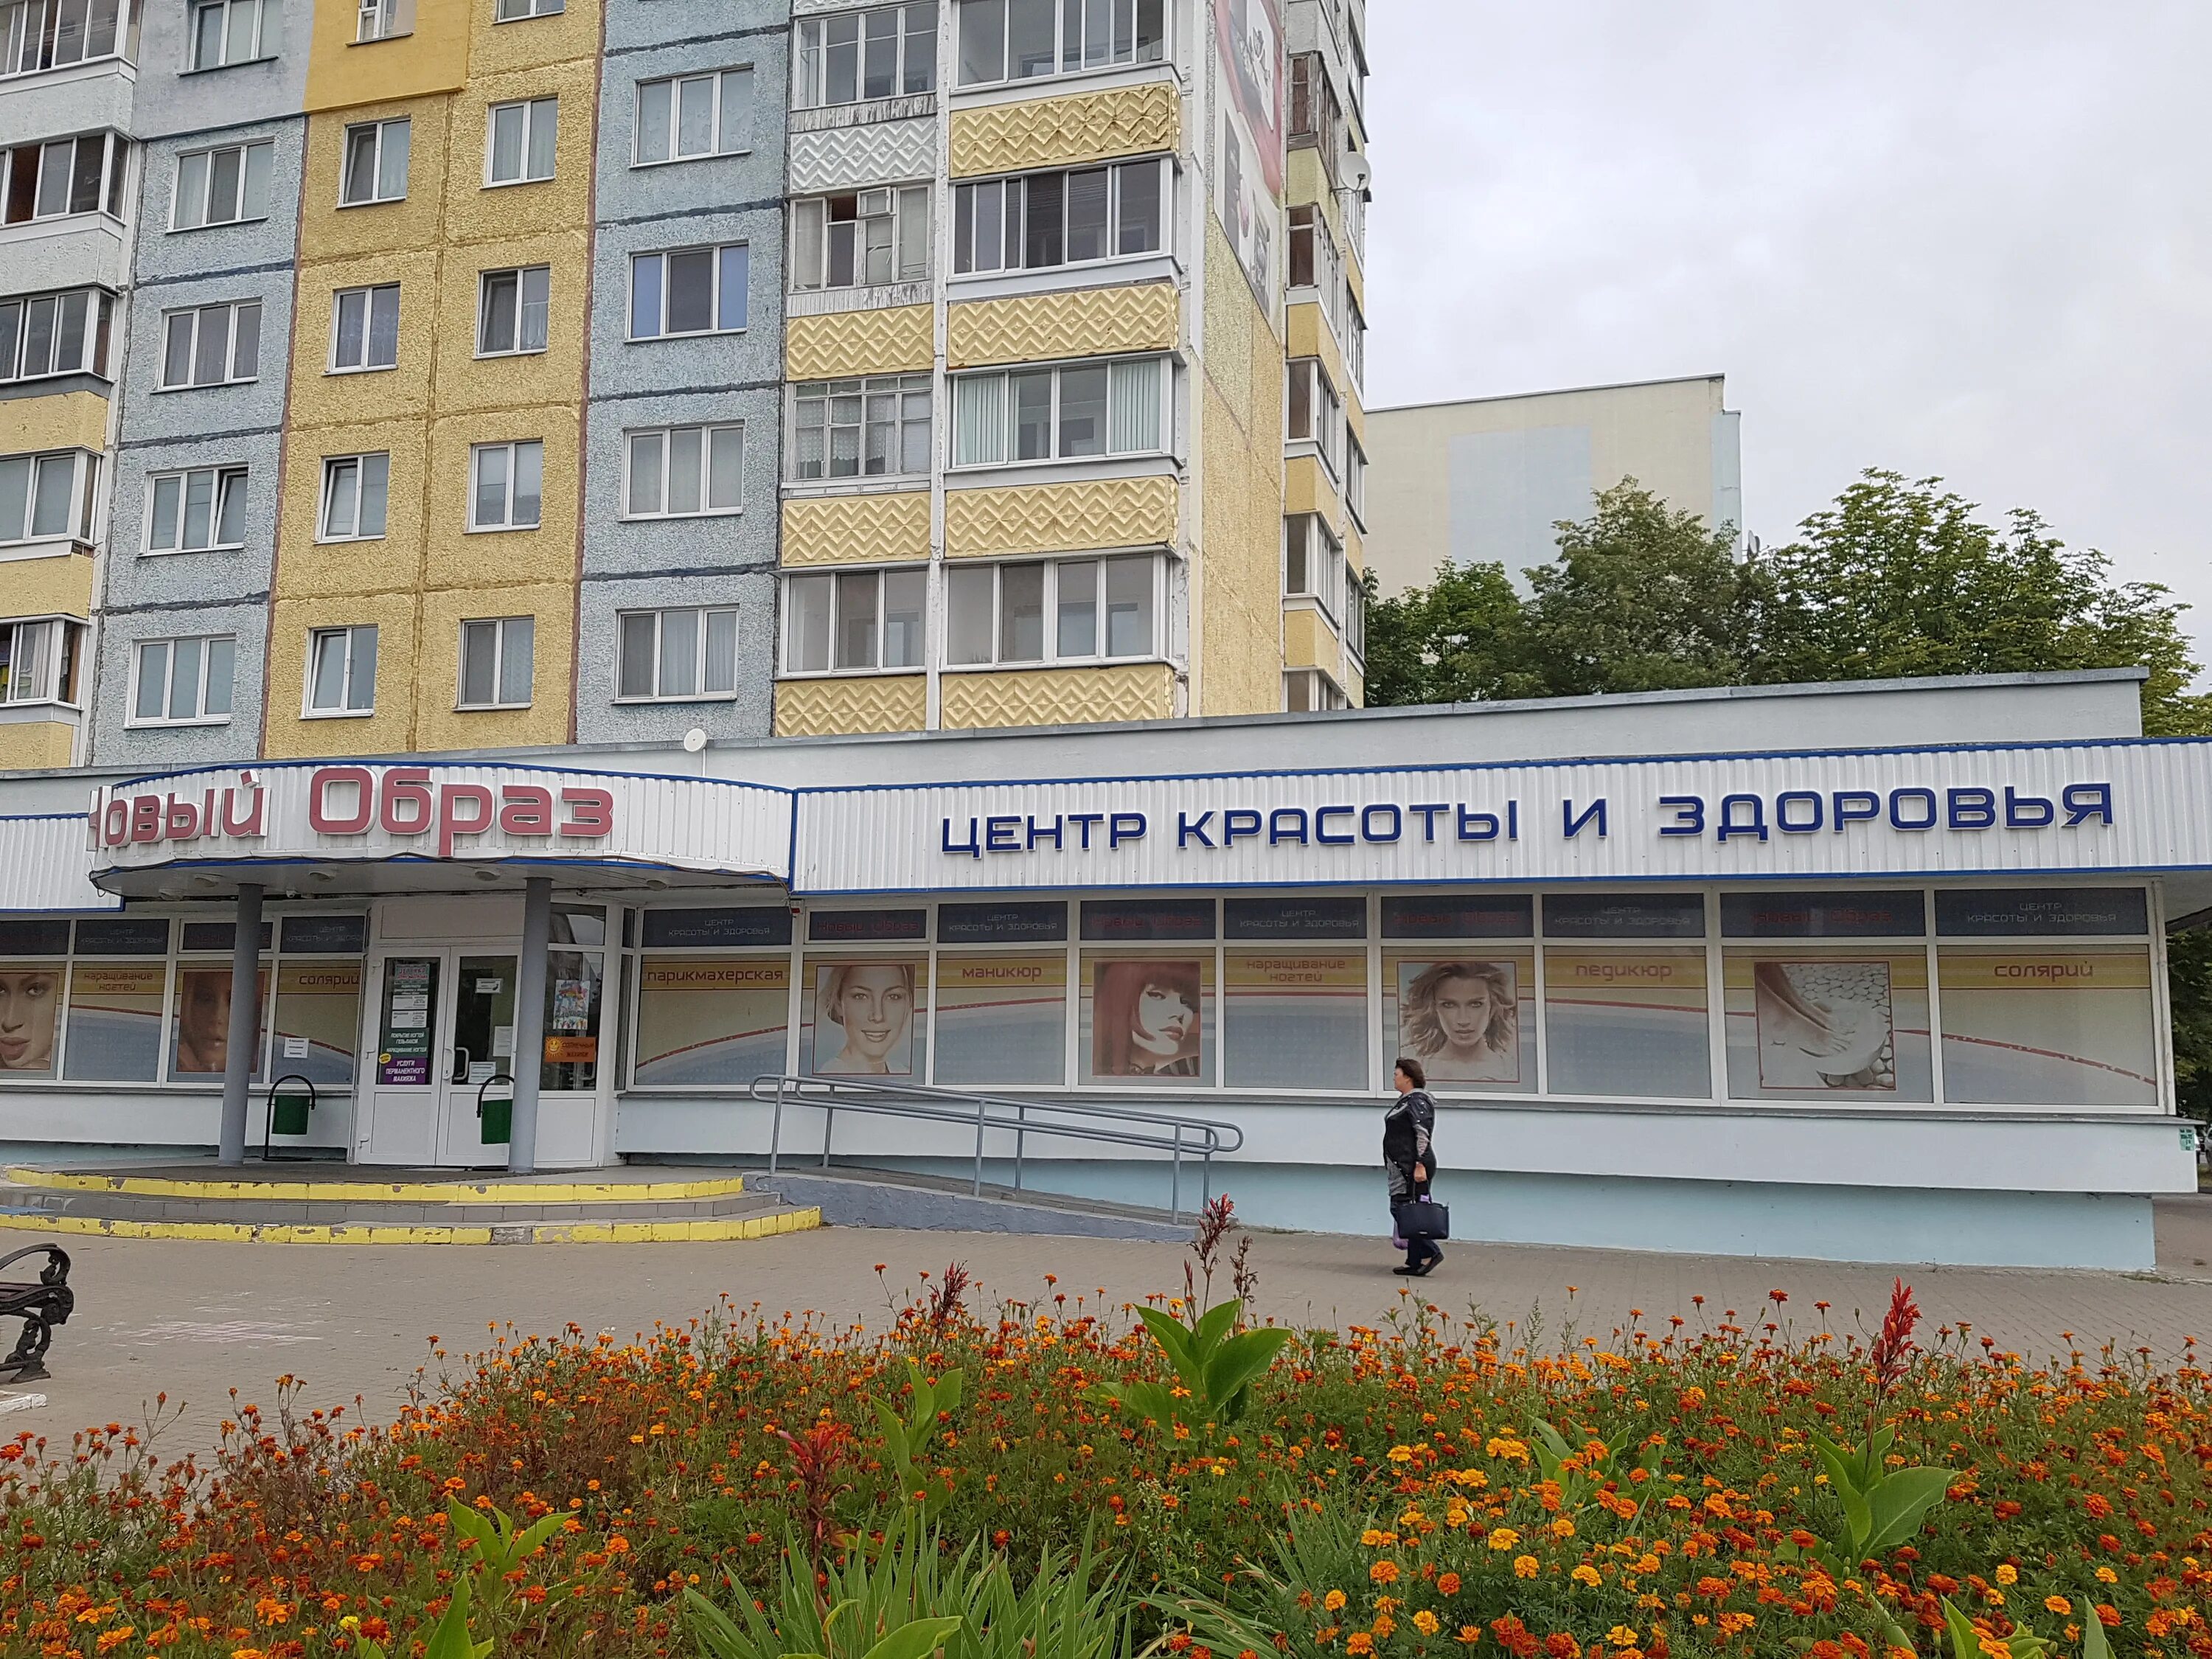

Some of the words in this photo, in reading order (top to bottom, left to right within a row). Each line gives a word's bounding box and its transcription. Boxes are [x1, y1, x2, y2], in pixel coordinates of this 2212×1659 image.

[309, 767, 614, 858] Образ
[942, 812, 1148, 859] ЦЕНТР
[1178, 799, 1519, 848] КРАСОТЫ
[1562, 798, 1608, 838] И
[1658, 782, 2115, 844] ЗДОРОВЬЯ
[1602, 906, 1641, 914] ЦЕНТР
[2019, 902, 2062, 911] ЦЕНТР
[987, 914, 1019, 922] ЦЕНТР
[1281, 909, 1317, 918] ЦЕНТР
[1966, 914, 2028, 922] КРАСОТЫ
[2048, 913, 2117, 922] ЗДОРОВЬЯ
[704, 919, 734, 927] ЦЕНТР
[948, 923, 993, 932] КРАСОТЫ
[1008, 922, 1058, 931] ЗДОРОВЬЯ
[1239, 919, 1288, 928] КРАСОТЫ
[1304, 919, 1360, 928] ЗДОРОВЬЯ
[668, 928, 710, 937] КРАСОТЫ
[723, 927, 771, 936] ЗДОРОВЬЯ
[1247, 959, 1346, 973] наращивание
[961, 966, 1042, 982] маникюр
[1576, 964, 1672, 982] педикюр
[1994, 961, 2094, 982] солярий
[84, 973, 153, 983] наращивание
[647, 970, 784, 985] парикмахерская
[1270, 972, 1323, 982] ногтей
[99, 983, 136, 991] ногтей
